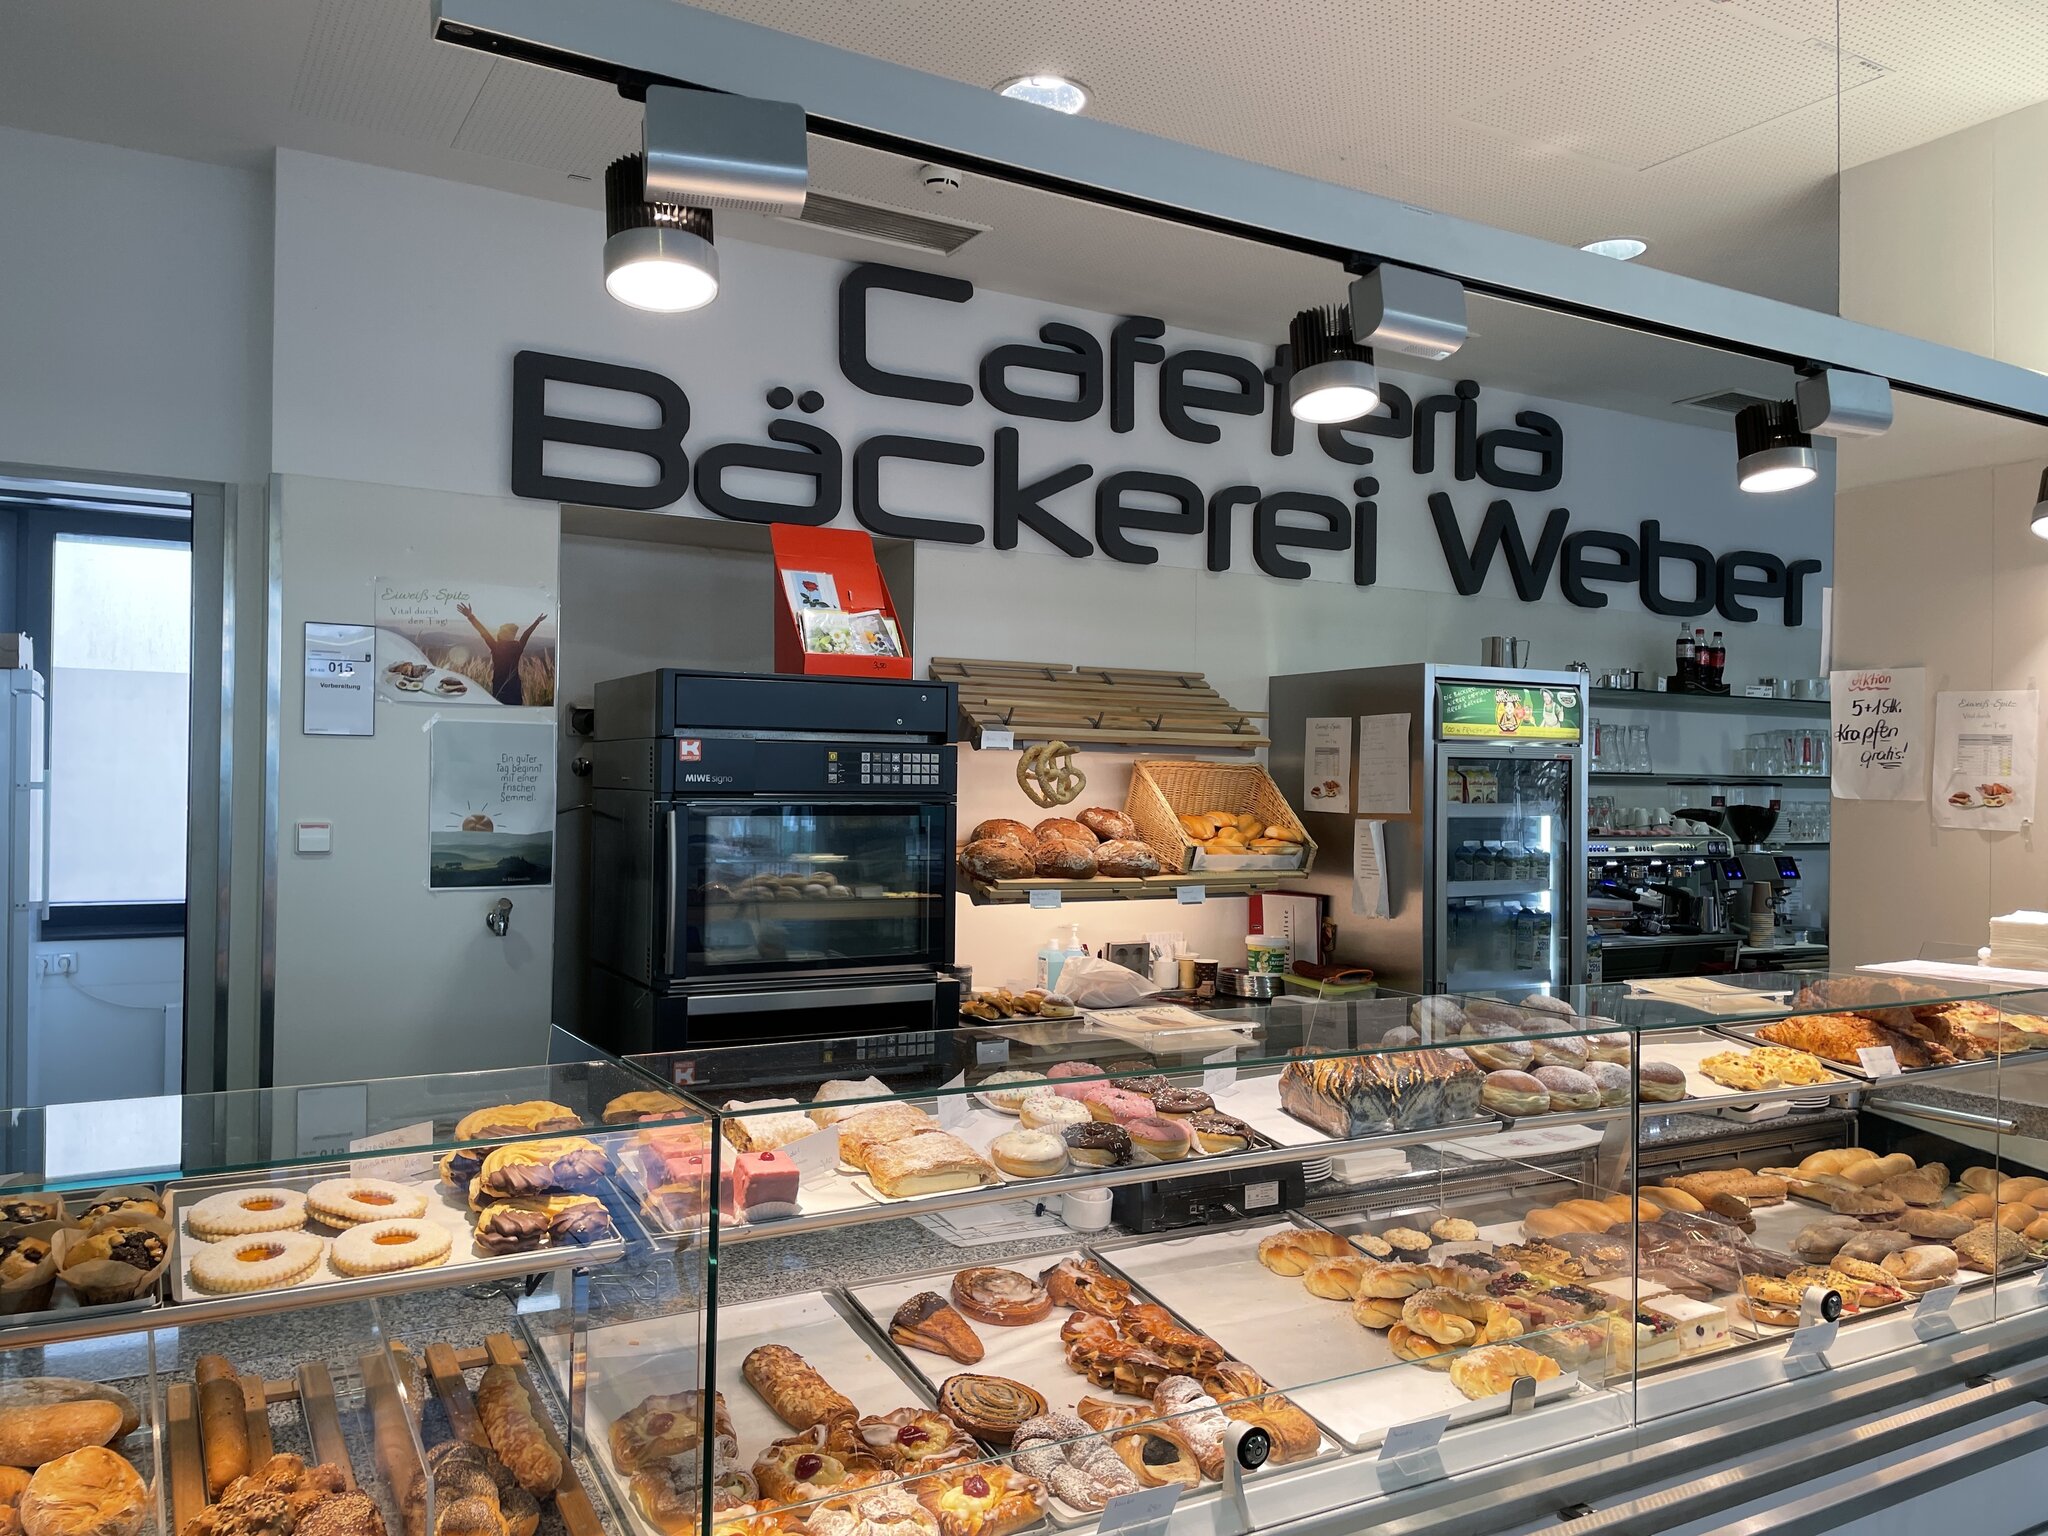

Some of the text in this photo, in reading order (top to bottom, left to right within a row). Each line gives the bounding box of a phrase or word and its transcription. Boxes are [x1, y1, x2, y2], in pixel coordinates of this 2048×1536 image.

[839, 263, 1564, 492] Cafeteria
[511, 350, 1822, 627] Bäckerei Weber
[328, 661, 353, 673] 015
[320, 682, 361, 691] Vorbereitung
[1835, 719, 1899, 748] Krapfen
[682, 741, 700, 755] K
[501, 753, 538, 766] Ein guter
[1860, 742, 1909, 768] gratis!
[496, 763, 543, 774] Tag beginnt
[500, 773, 539, 782] mit einer
[685, 774, 733, 785] MIWE signo
[500, 791, 537, 803] Semmel.
